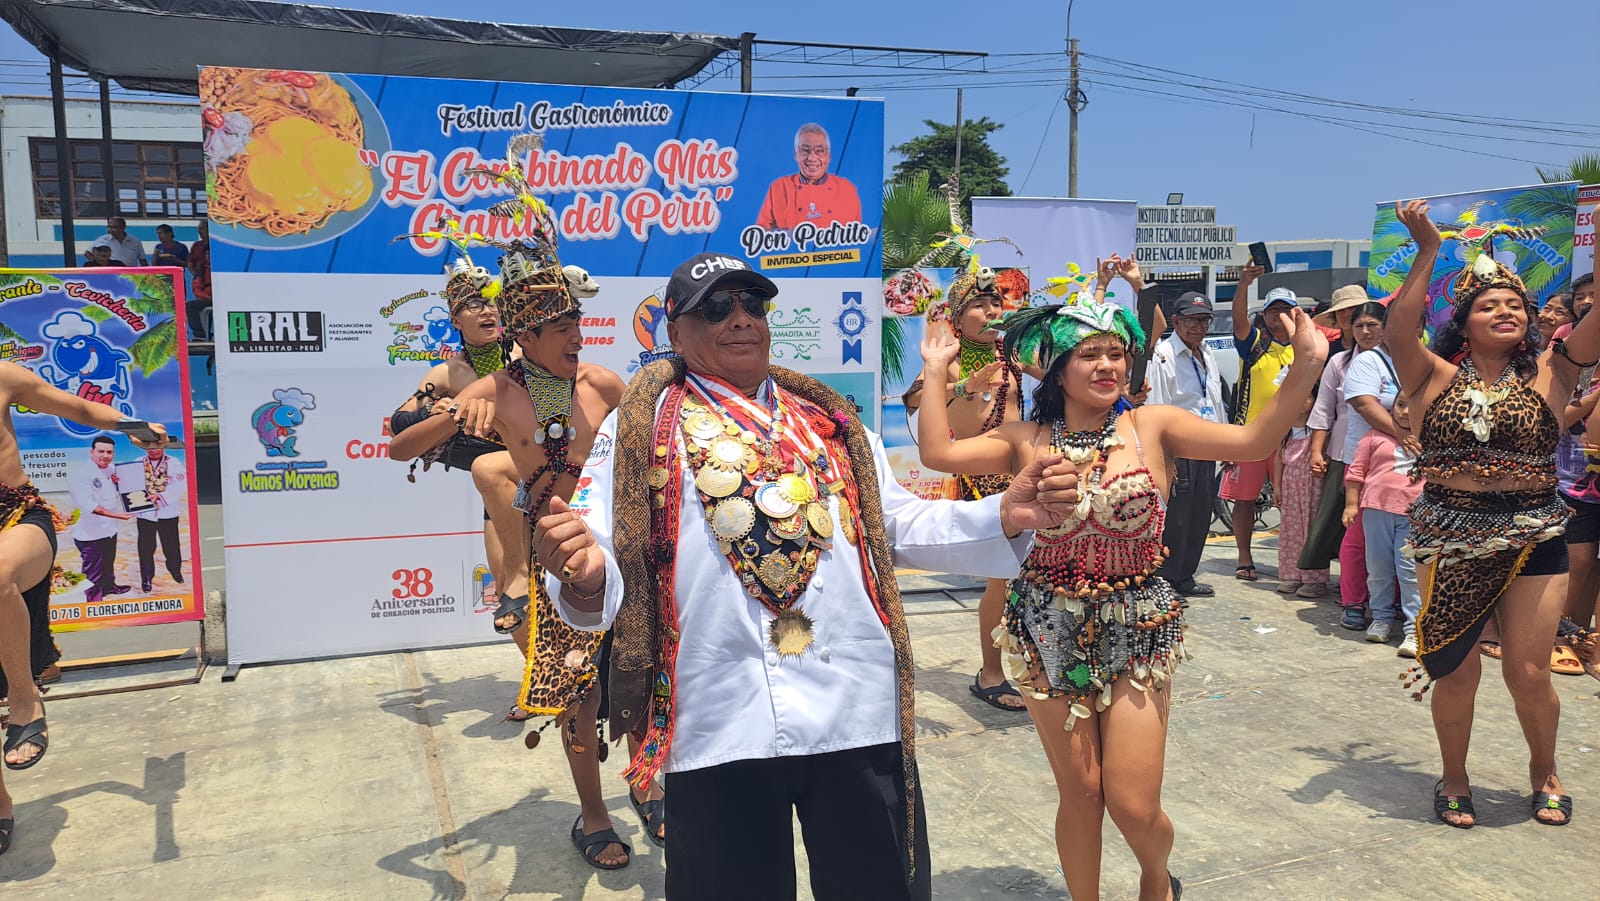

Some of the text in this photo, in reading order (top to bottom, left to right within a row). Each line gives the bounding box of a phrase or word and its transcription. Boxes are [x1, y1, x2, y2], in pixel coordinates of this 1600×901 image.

[439, 101, 669, 134] Festival Gastronómico
[658, 142, 733, 186] Más
[412, 202, 552, 249] Grand
[564, 194, 613, 233] del
[1138, 208, 1168, 223] INSTITUTO
[1171, 208, 1179, 223] DE
[742, 220, 869, 256] Don Pedrito
[767, 252, 854, 266] INVITADO ESPECIAL
[1186, 247, 1198, 260] DE
[690, 256, 746, 280] CHEF
[229, 312, 318, 341] ARAL
[23, 451, 66, 460] pescados
[240, 469, 339, 491] Manos Morenas
[392, 567, 434, 598] 38
[62, 607, 80, 619] 716
[87, 602, 140, 617] FLORENCIA
[143, 599, 182, 612] DEMORA
[371, 593, 455, 610] Aniversario
[383, 608, 420, 617] CREACIÓN
